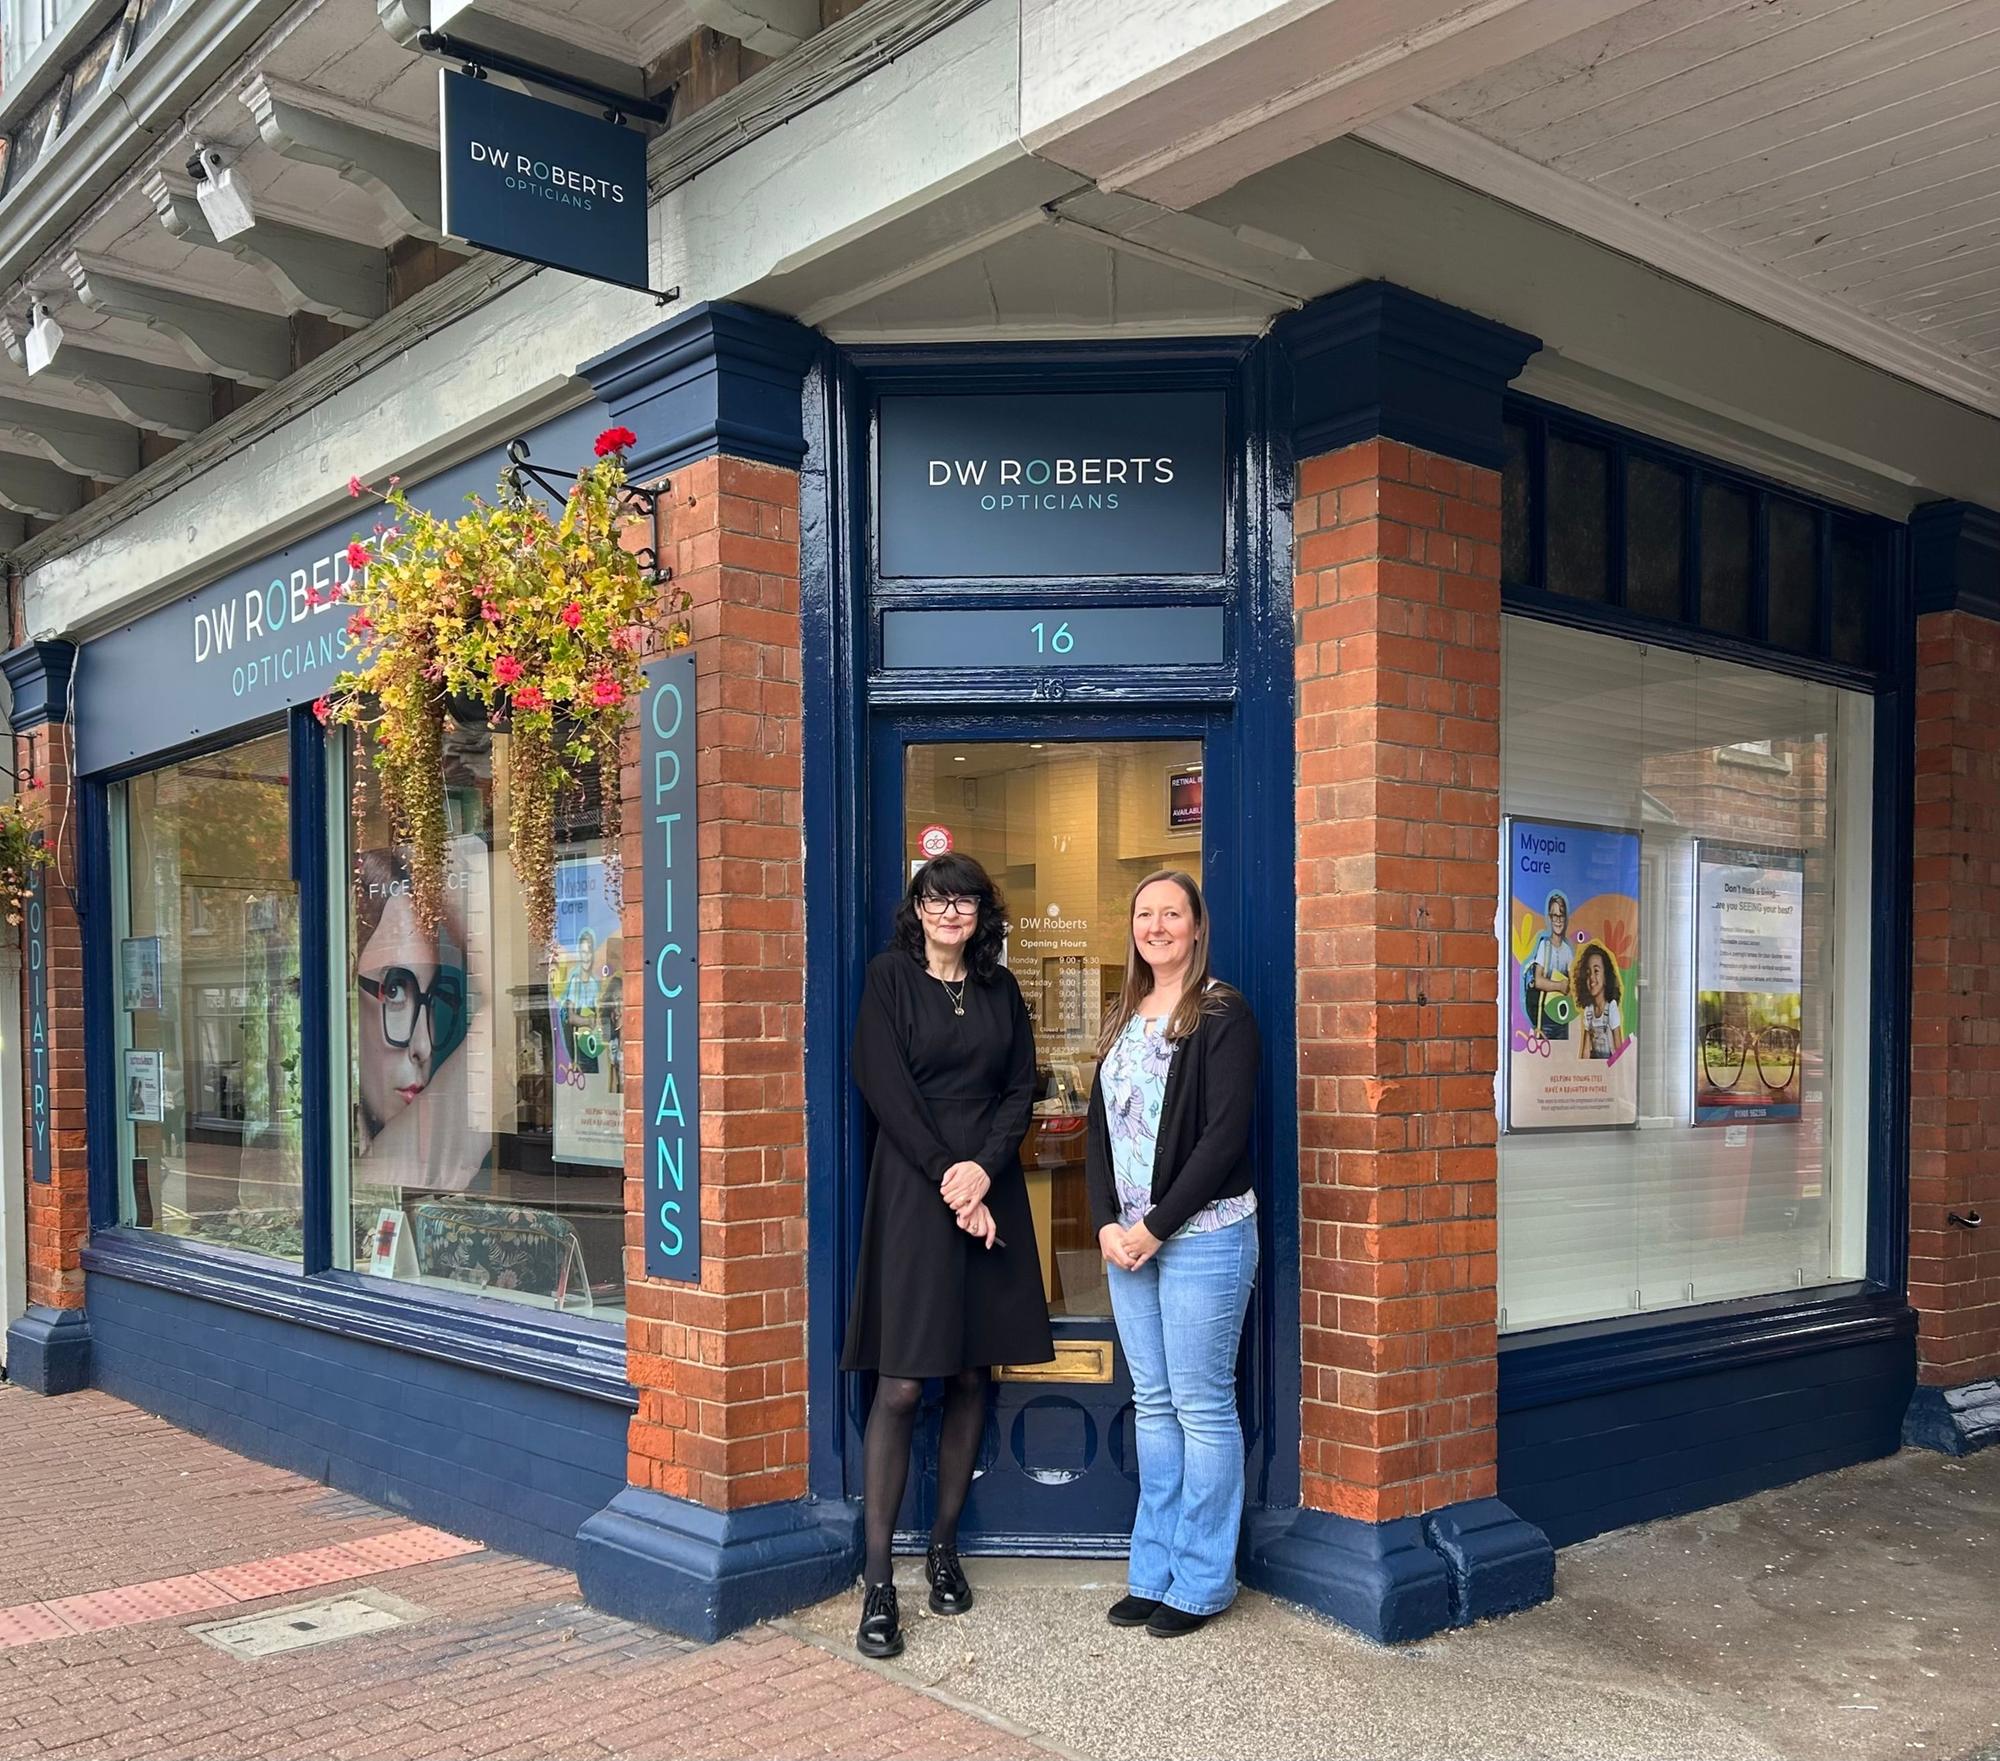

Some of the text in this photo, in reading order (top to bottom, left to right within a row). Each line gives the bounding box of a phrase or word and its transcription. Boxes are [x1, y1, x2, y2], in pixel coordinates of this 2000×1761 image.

[470, 141, 625, 203] DW ROBERTS
[504, 176, 592, 211] OPTICIANS
[928, 457, 1174, 486] DW ROBERTS
[980, 493, 1119, 511] OPTICIANS
[194, 599, 237, 663] DW
[1030, 622, 1074, 654] 16
[232, 628, 348, 697] OPTICIANS
[1172, 807, 1202, 816] AVAILABL
[1520, 833, 1566, 855] Myopia
[1520, 855, 1551, 875] Care
[369, 879, 410, 899] FACE
[1020, 918, 1088, 929] DW Roberts
[1020, 939, 1088, 949] Opening Hours
[652, 683, 685, 1256] OPTICIANS
